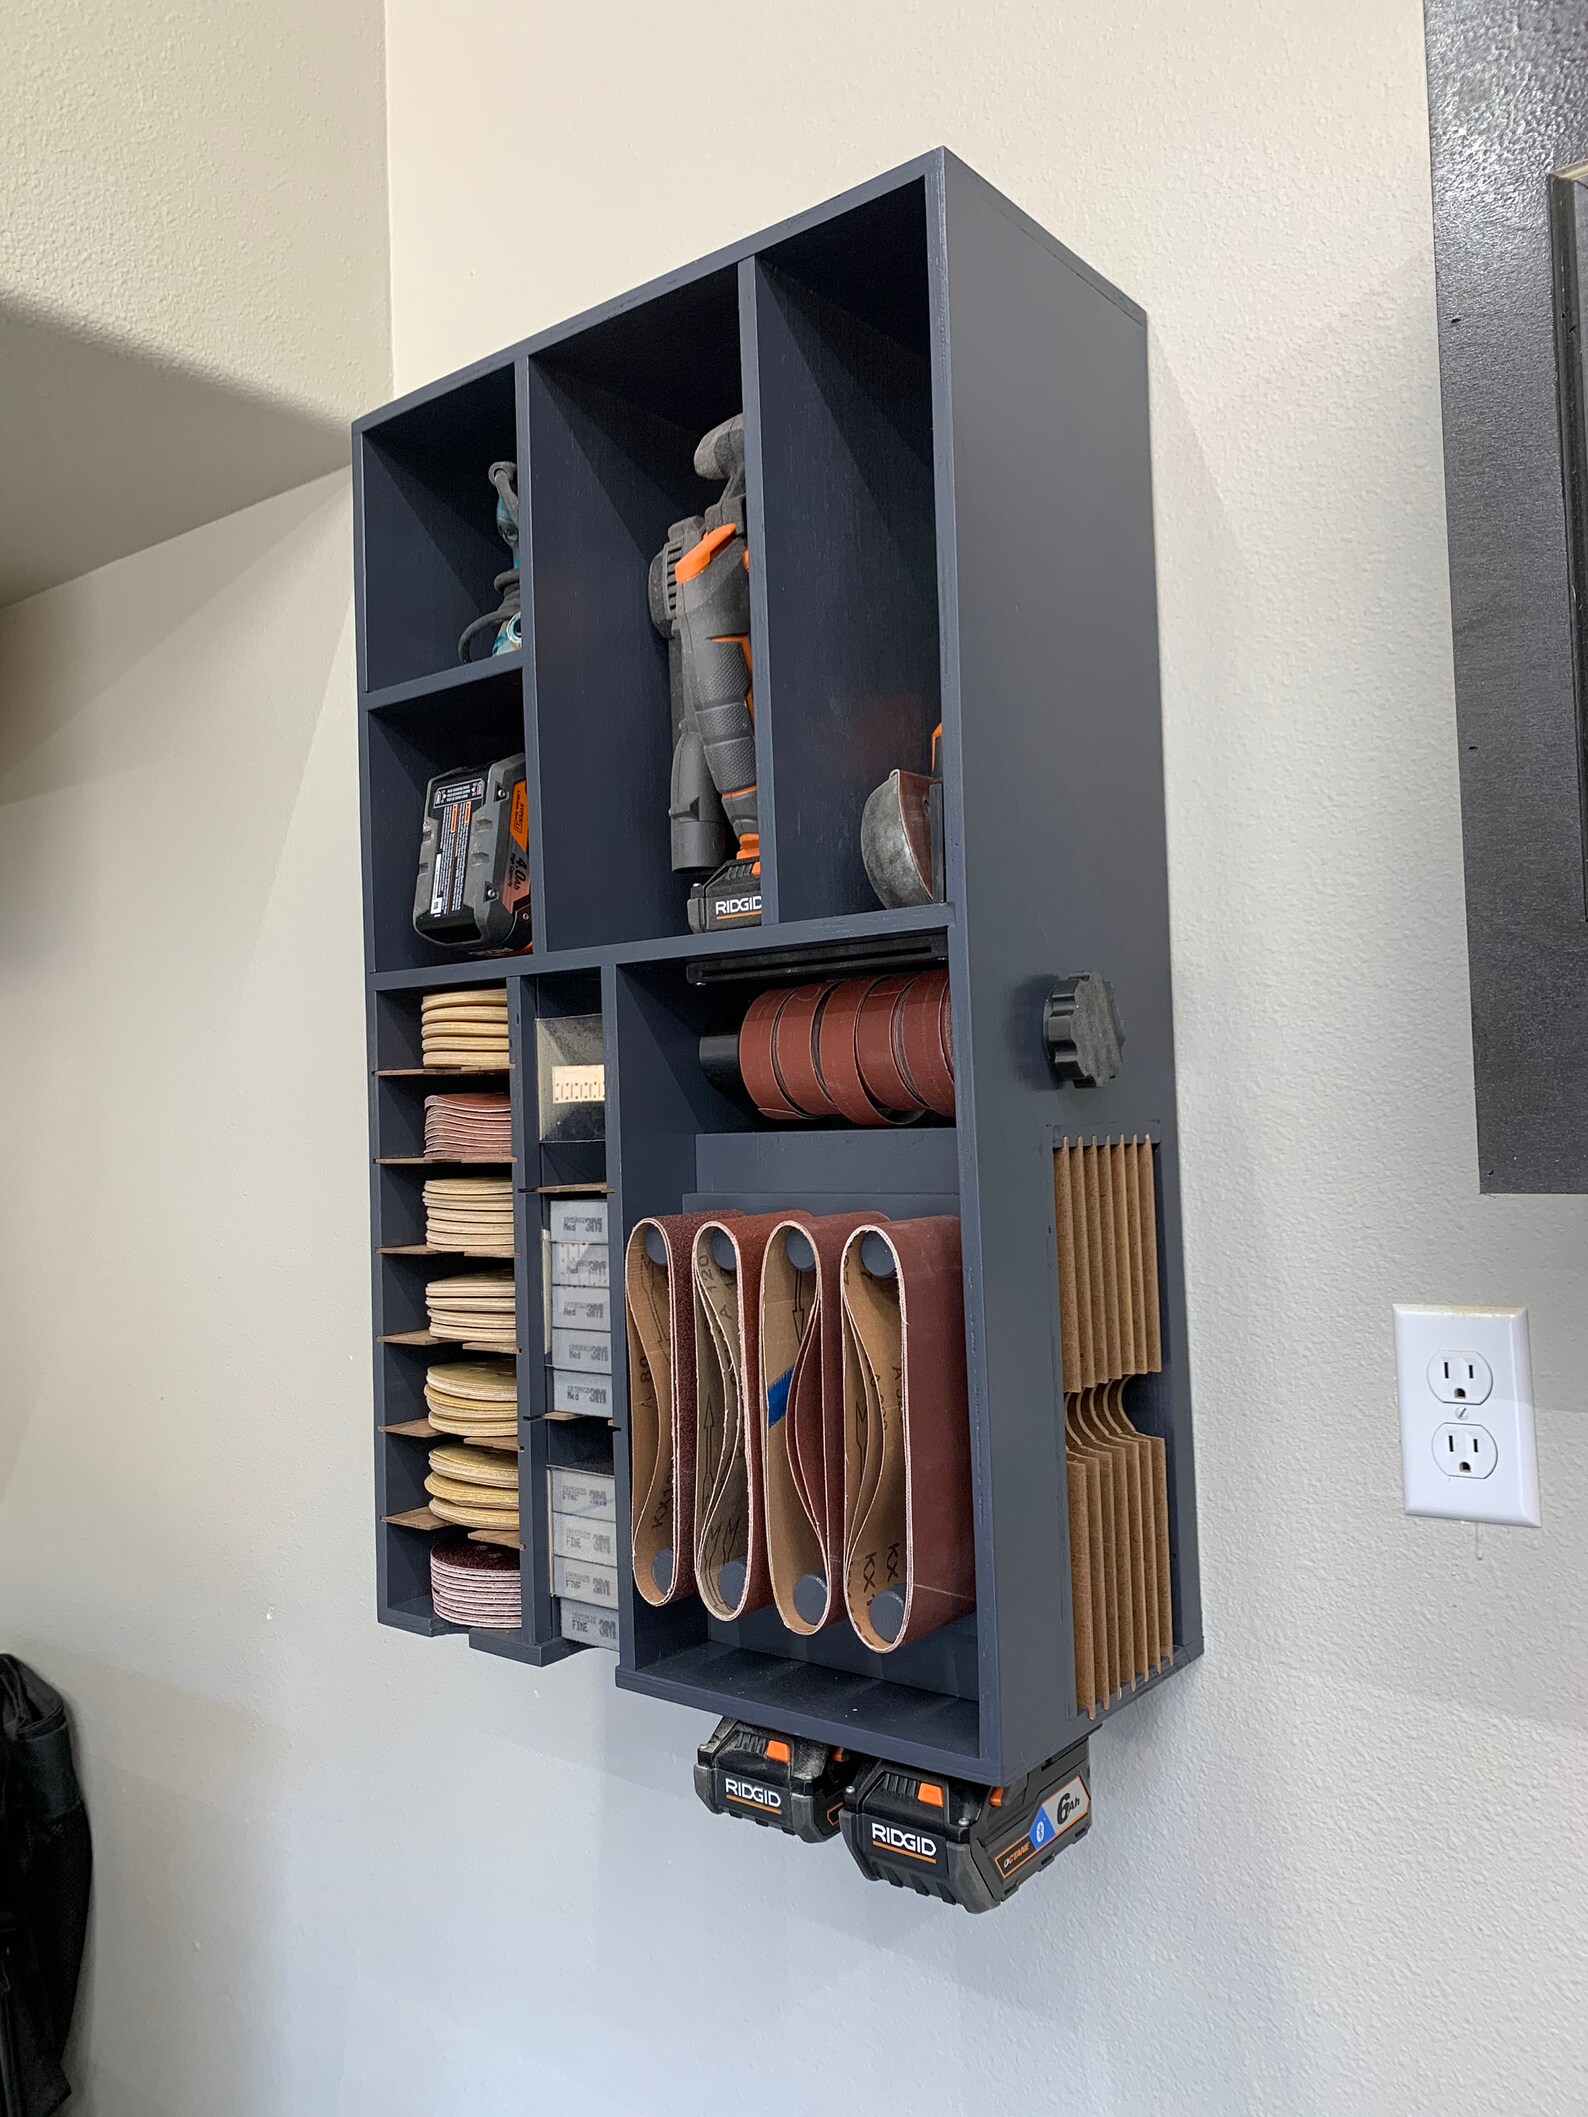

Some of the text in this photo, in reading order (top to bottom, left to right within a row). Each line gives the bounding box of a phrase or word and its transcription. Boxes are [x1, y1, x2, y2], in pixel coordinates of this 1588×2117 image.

[513, 858, 527, 890] 4.0Ah
[715, 895, 762, 915] RIDGID
[698, 1255, 717, 1293] 120
[640, 1356, 653, 1384] 80
[725, 1778, 781, 1807] RIDGID
[872, 1822, 936, 1856] RIDGID
